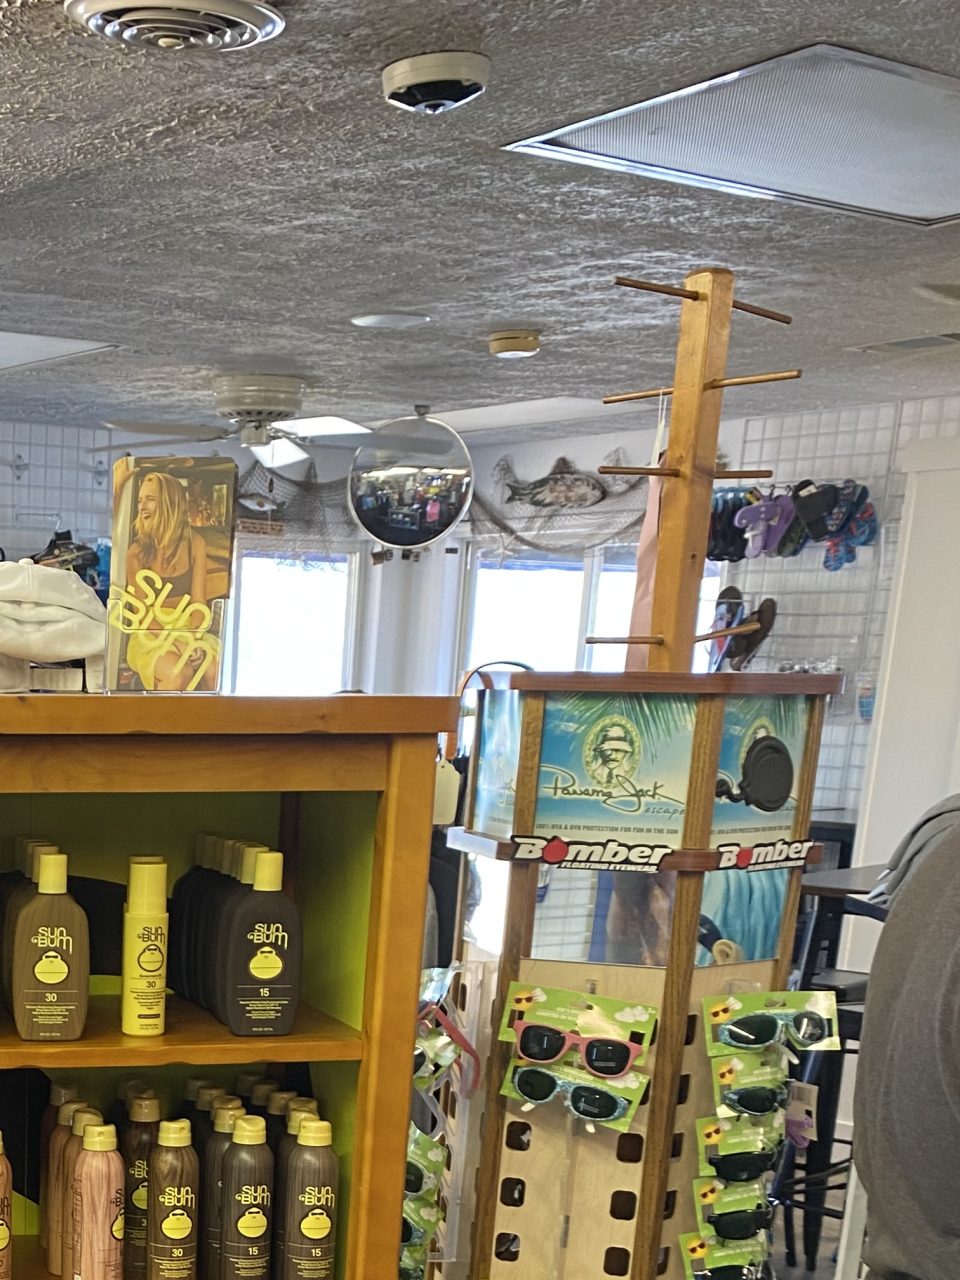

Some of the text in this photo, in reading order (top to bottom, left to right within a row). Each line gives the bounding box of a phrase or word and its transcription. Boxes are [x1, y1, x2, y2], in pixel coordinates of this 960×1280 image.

[540, 764, 685, 813] Panama Jack
[645, 805, 685, 820] escape
[259, 988, 270, 996] 15
[45, 993, 57, 1002] 30
[171, 1248, 183, 1257] 30
[248, 1246, 259, 1255] 15
[311, 1248, 322, 1257] 15
